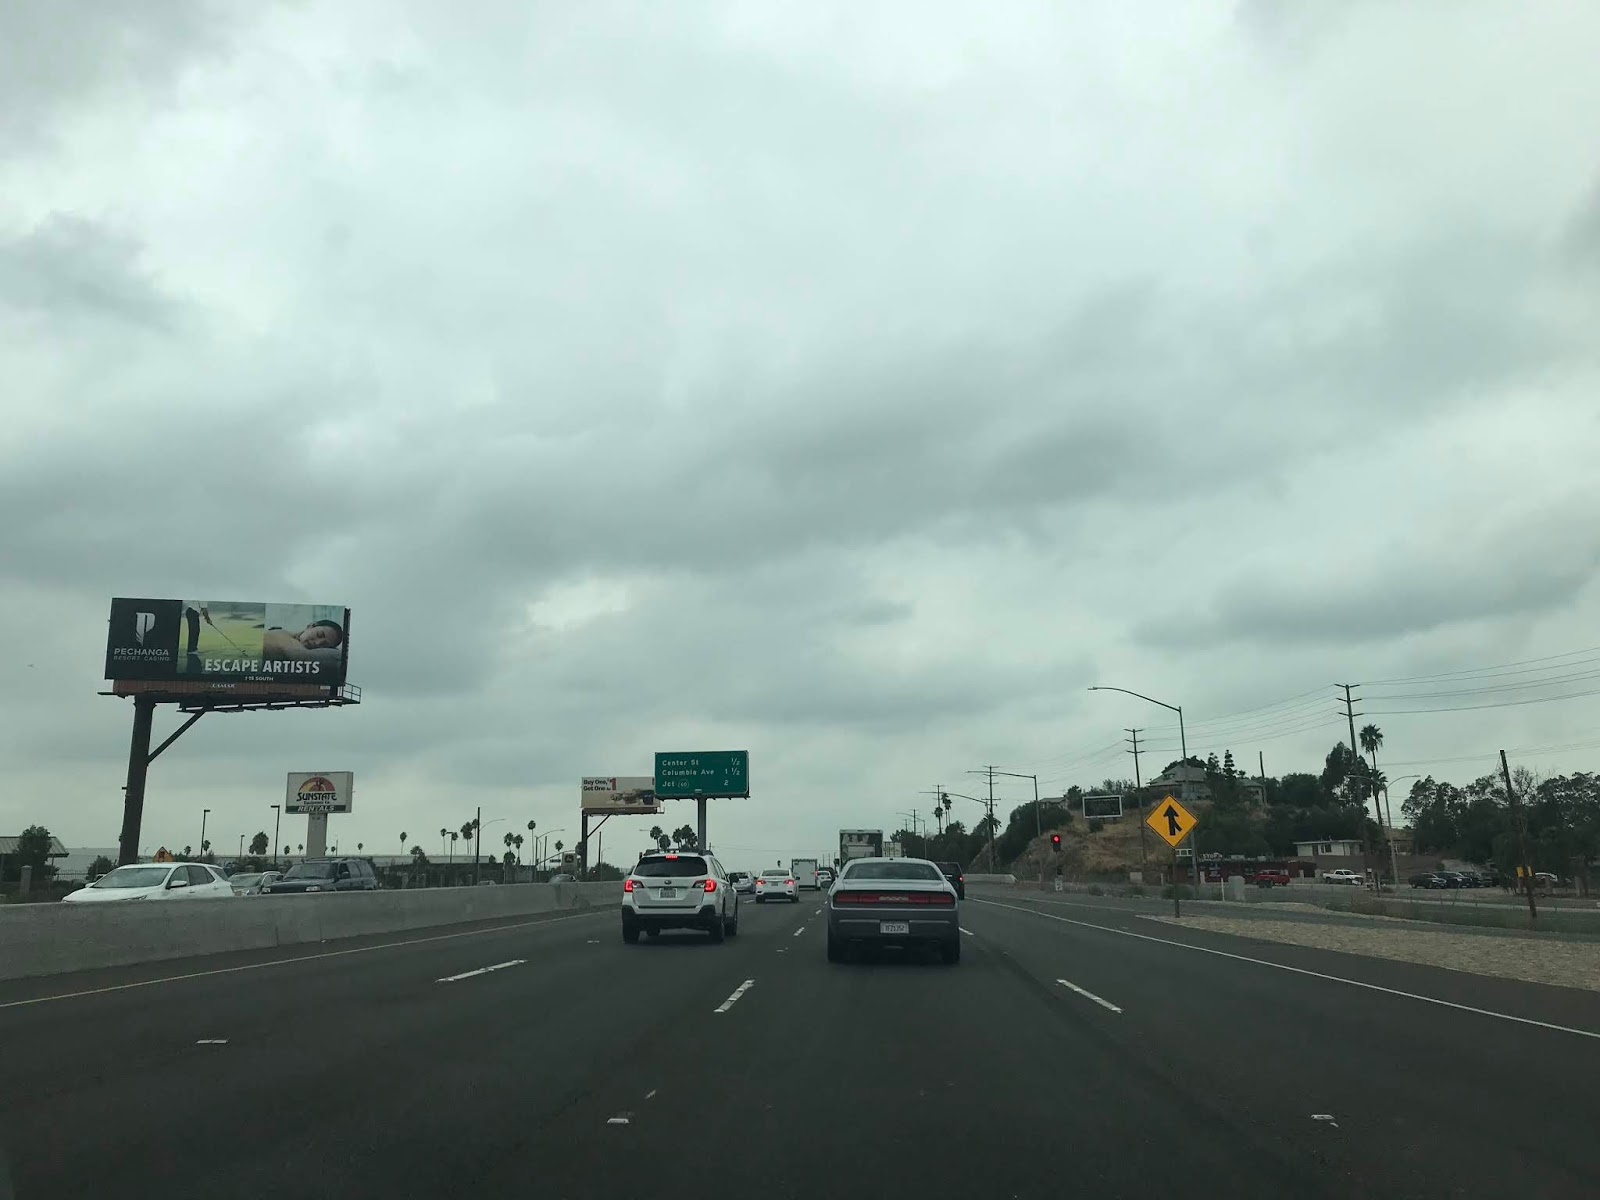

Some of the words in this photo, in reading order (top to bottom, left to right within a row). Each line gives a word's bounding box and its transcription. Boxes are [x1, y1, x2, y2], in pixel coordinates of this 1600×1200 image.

[114, 648, 169, 656] PECHANGA
[204, 658, 258, 672] ESCAPE
[262, 660, 320, 674] ARTISTS
[296, 793, 337, 801] SUNSTATE
